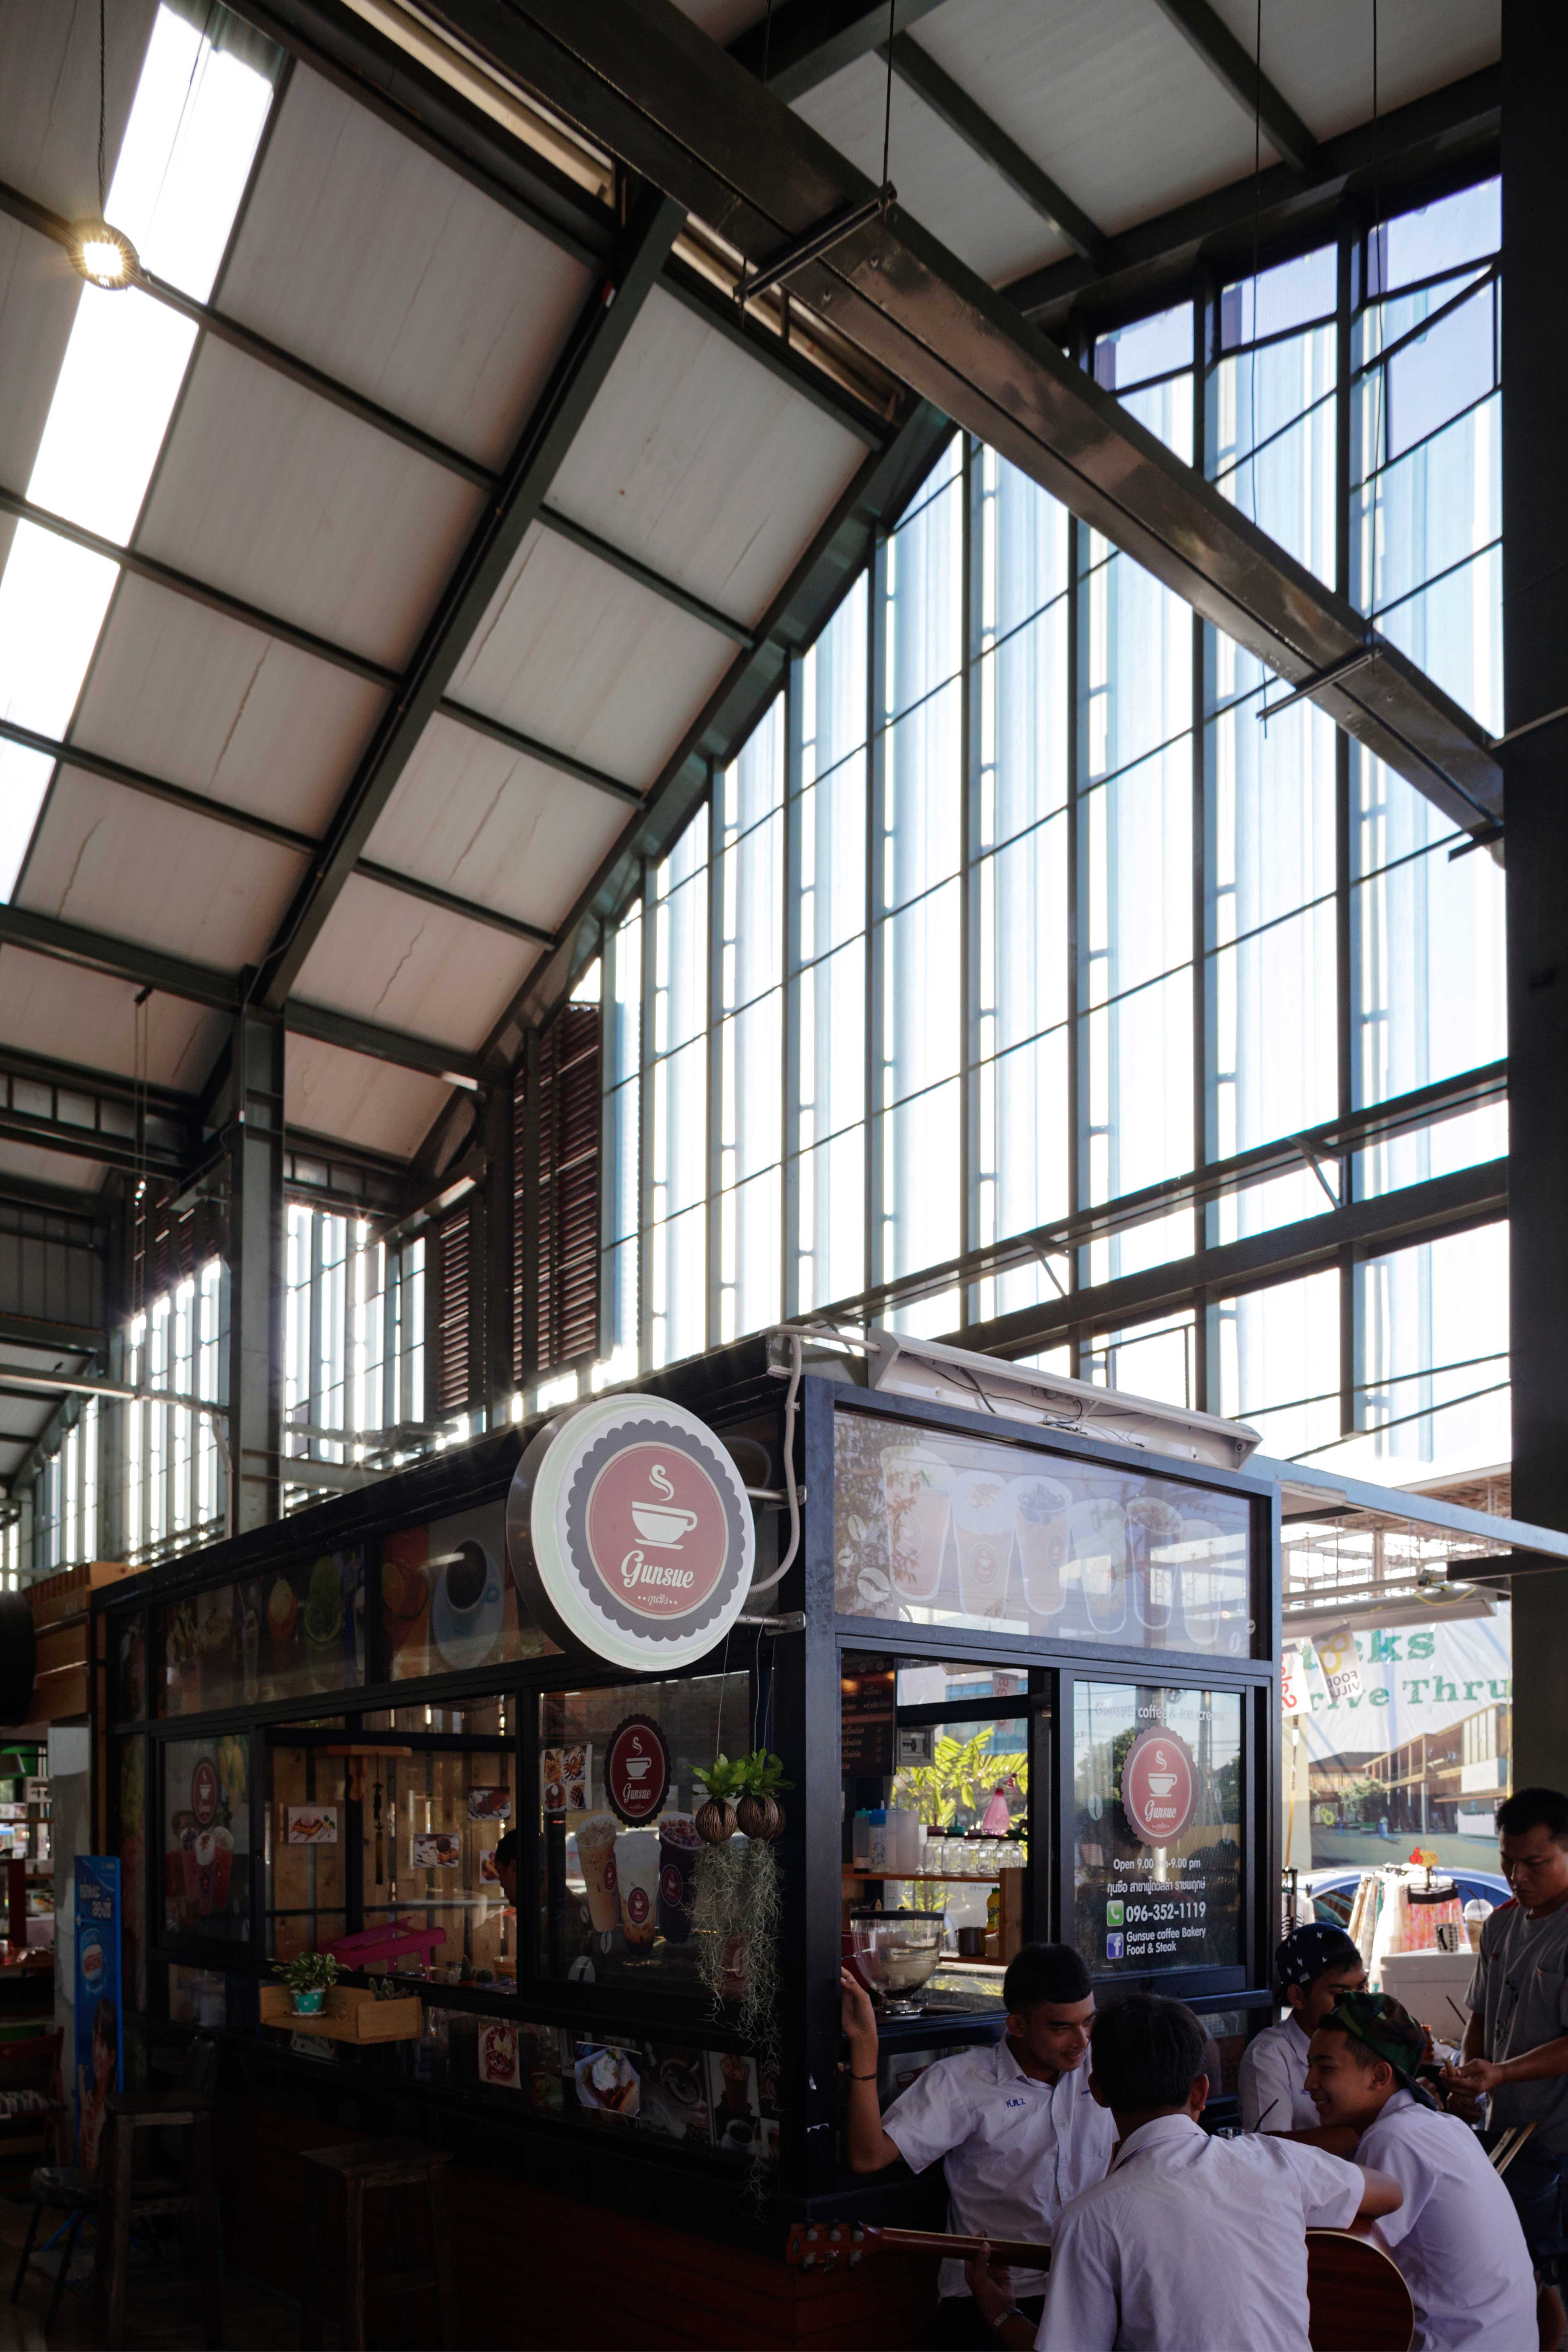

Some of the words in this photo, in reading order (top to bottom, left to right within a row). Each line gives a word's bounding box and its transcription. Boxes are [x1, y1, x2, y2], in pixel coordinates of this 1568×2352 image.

[621, 1550, 694, 1588] Gunsue
[1402, 1676, 1512, 1704] Thru
[1138, 1705, 1167, 1718] coffee
[623, 1783, 651, 1803] Gunsue
[1144, 1800, 1176, 1822] Gunsue
[1113, 1858, 1135, 1872] Open
[1137, 1858, 1153, 1869] 9.00
[1126, 1901, 1206, 1922] 096-352-1119
[1126, 1931, 1155, 1942] Gunsue
[1157, 1928, 1180, 1939] coffee
[1182, 1926, 1206, 1939] Bakery
[1127, 1943, 1145, 1955] Food
[1147, 1942, 1154, 1953] &
[1155, 1940, 1176, 1952] Steak
